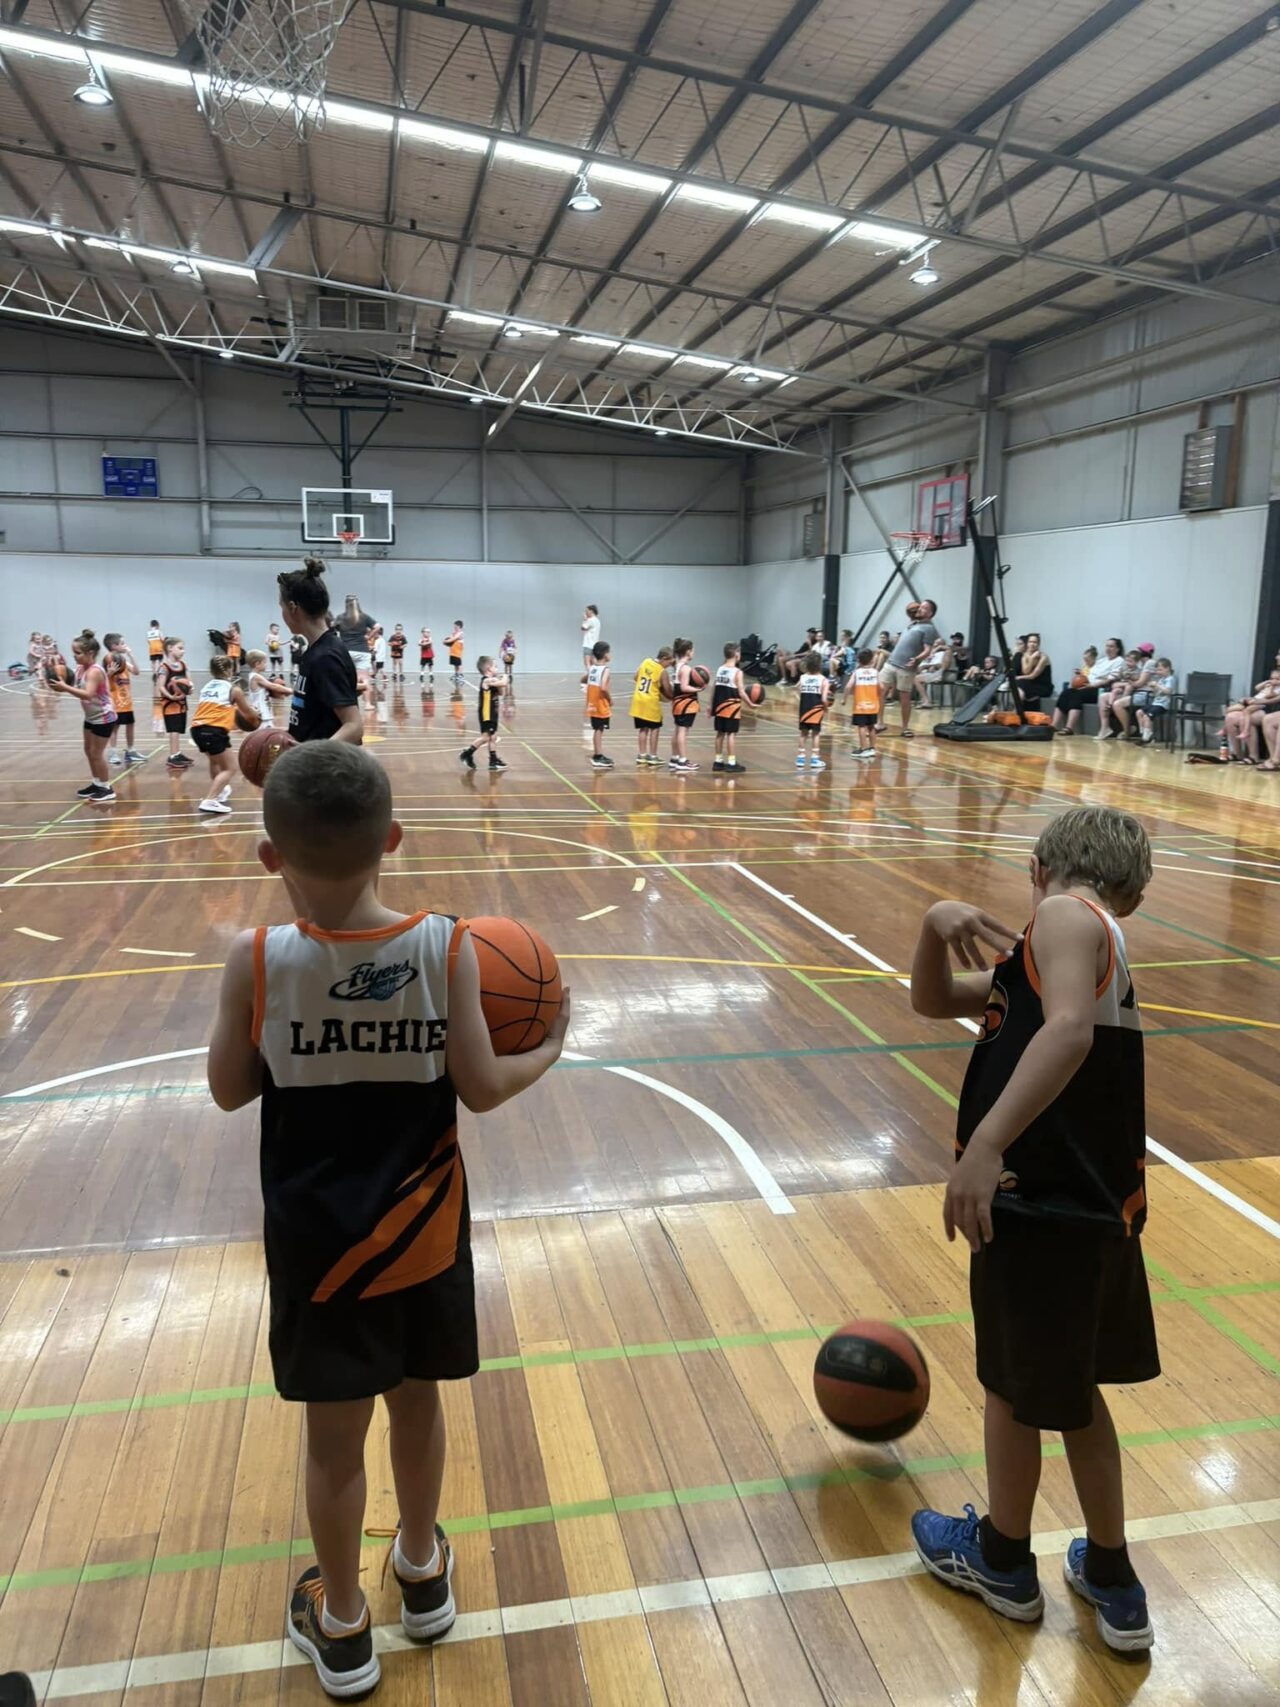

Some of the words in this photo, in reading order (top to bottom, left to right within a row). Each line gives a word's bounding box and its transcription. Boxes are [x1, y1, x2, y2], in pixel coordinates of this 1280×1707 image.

[638, 676, 652, 694] 31
[349, 959, 410, 989] Flyers
[291, 1019, 447, 1055] LACHIE
